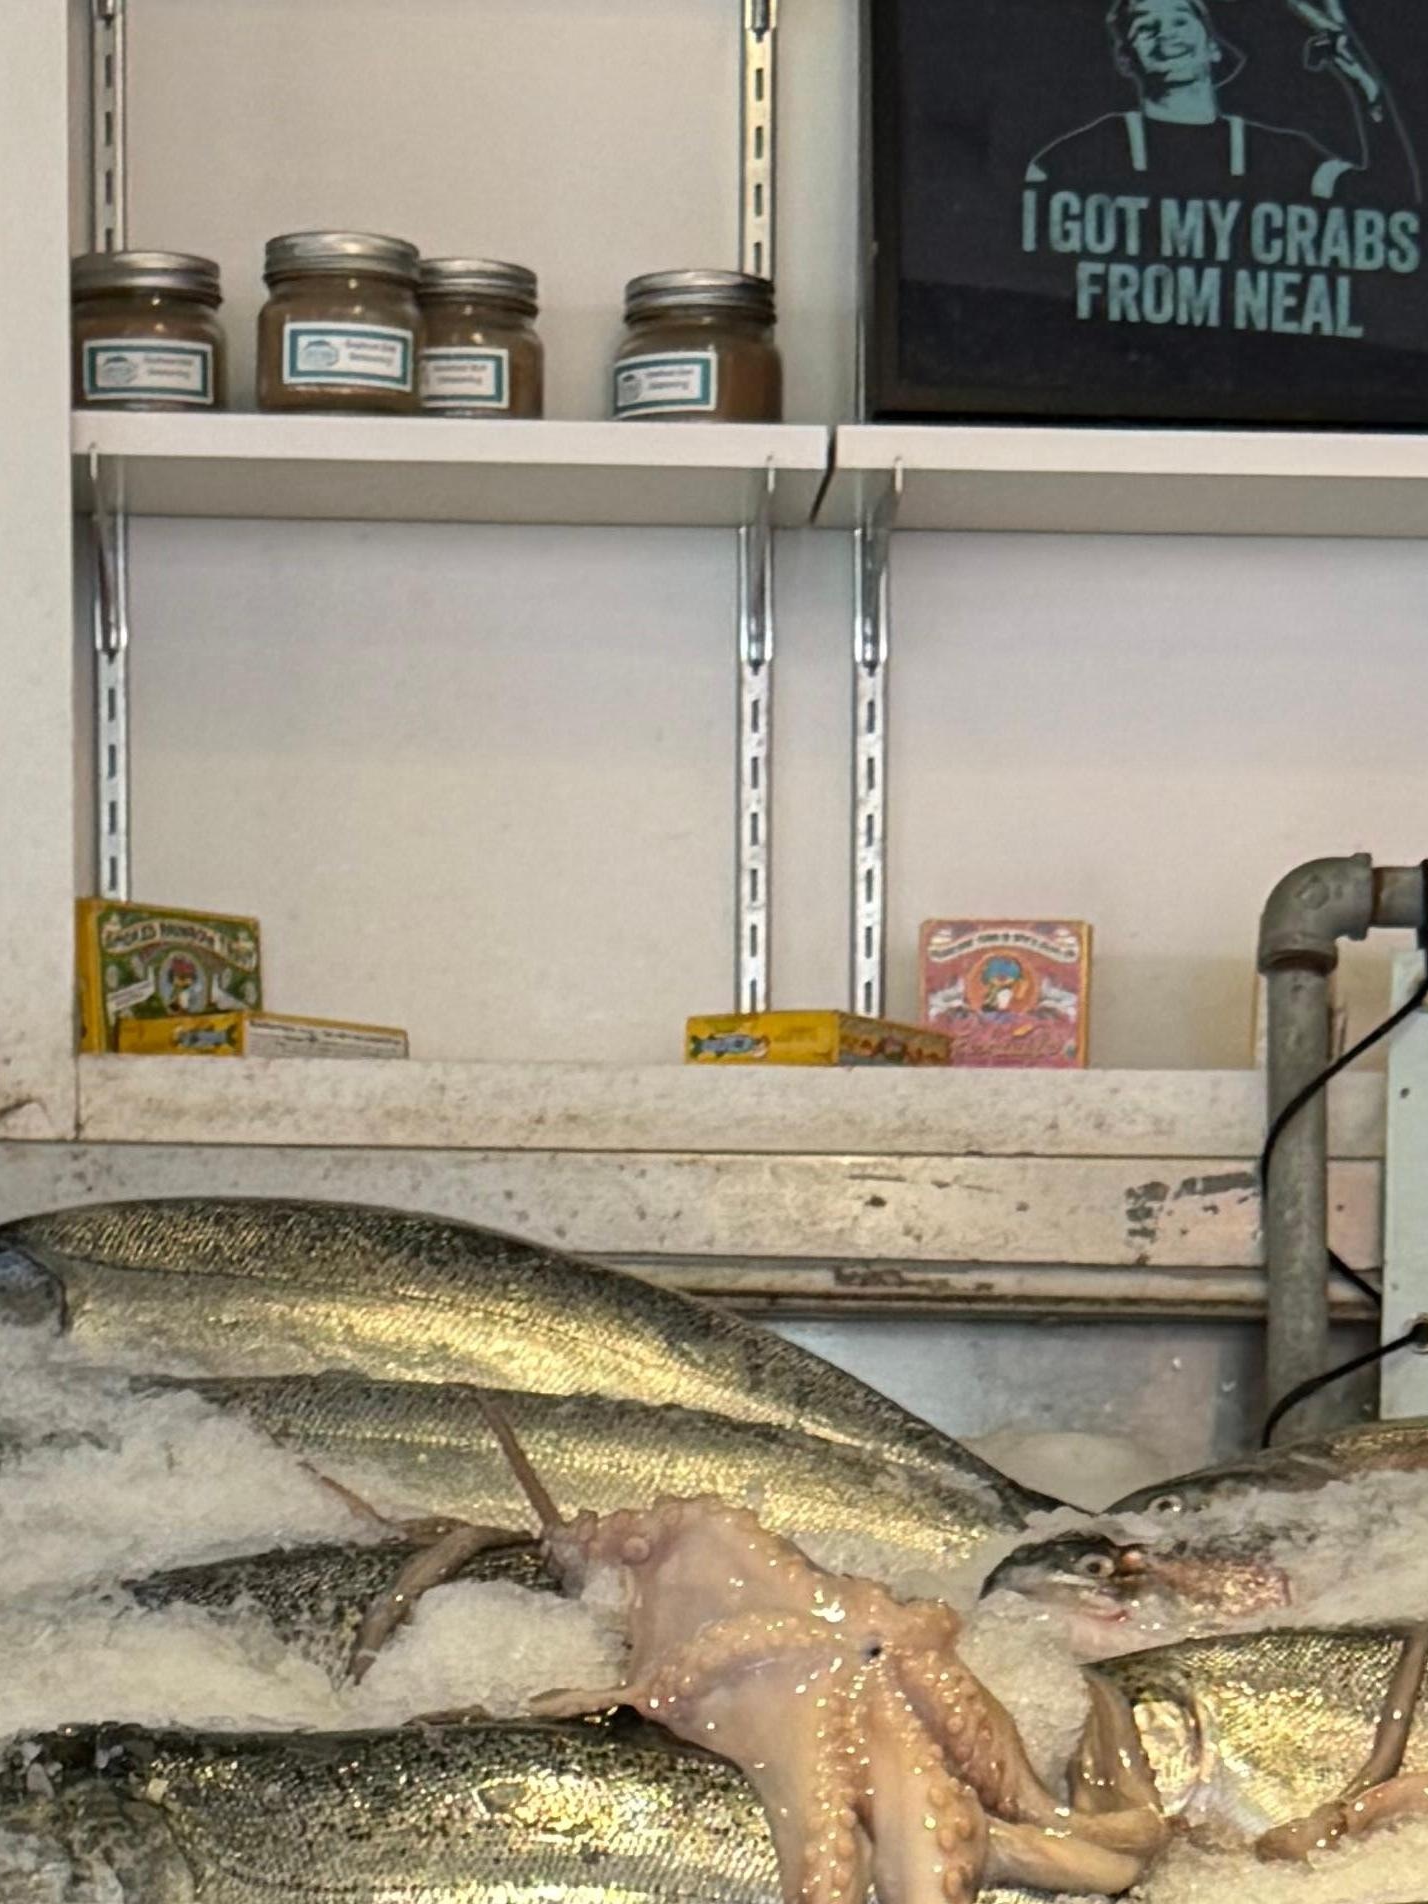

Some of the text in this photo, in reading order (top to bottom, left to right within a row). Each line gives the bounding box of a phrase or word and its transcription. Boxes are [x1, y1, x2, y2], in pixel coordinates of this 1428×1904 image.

[1022, 190, 1420, 273] I GOT MY CRABS
[1076, 261, 1364, 339] FROM NEAL
